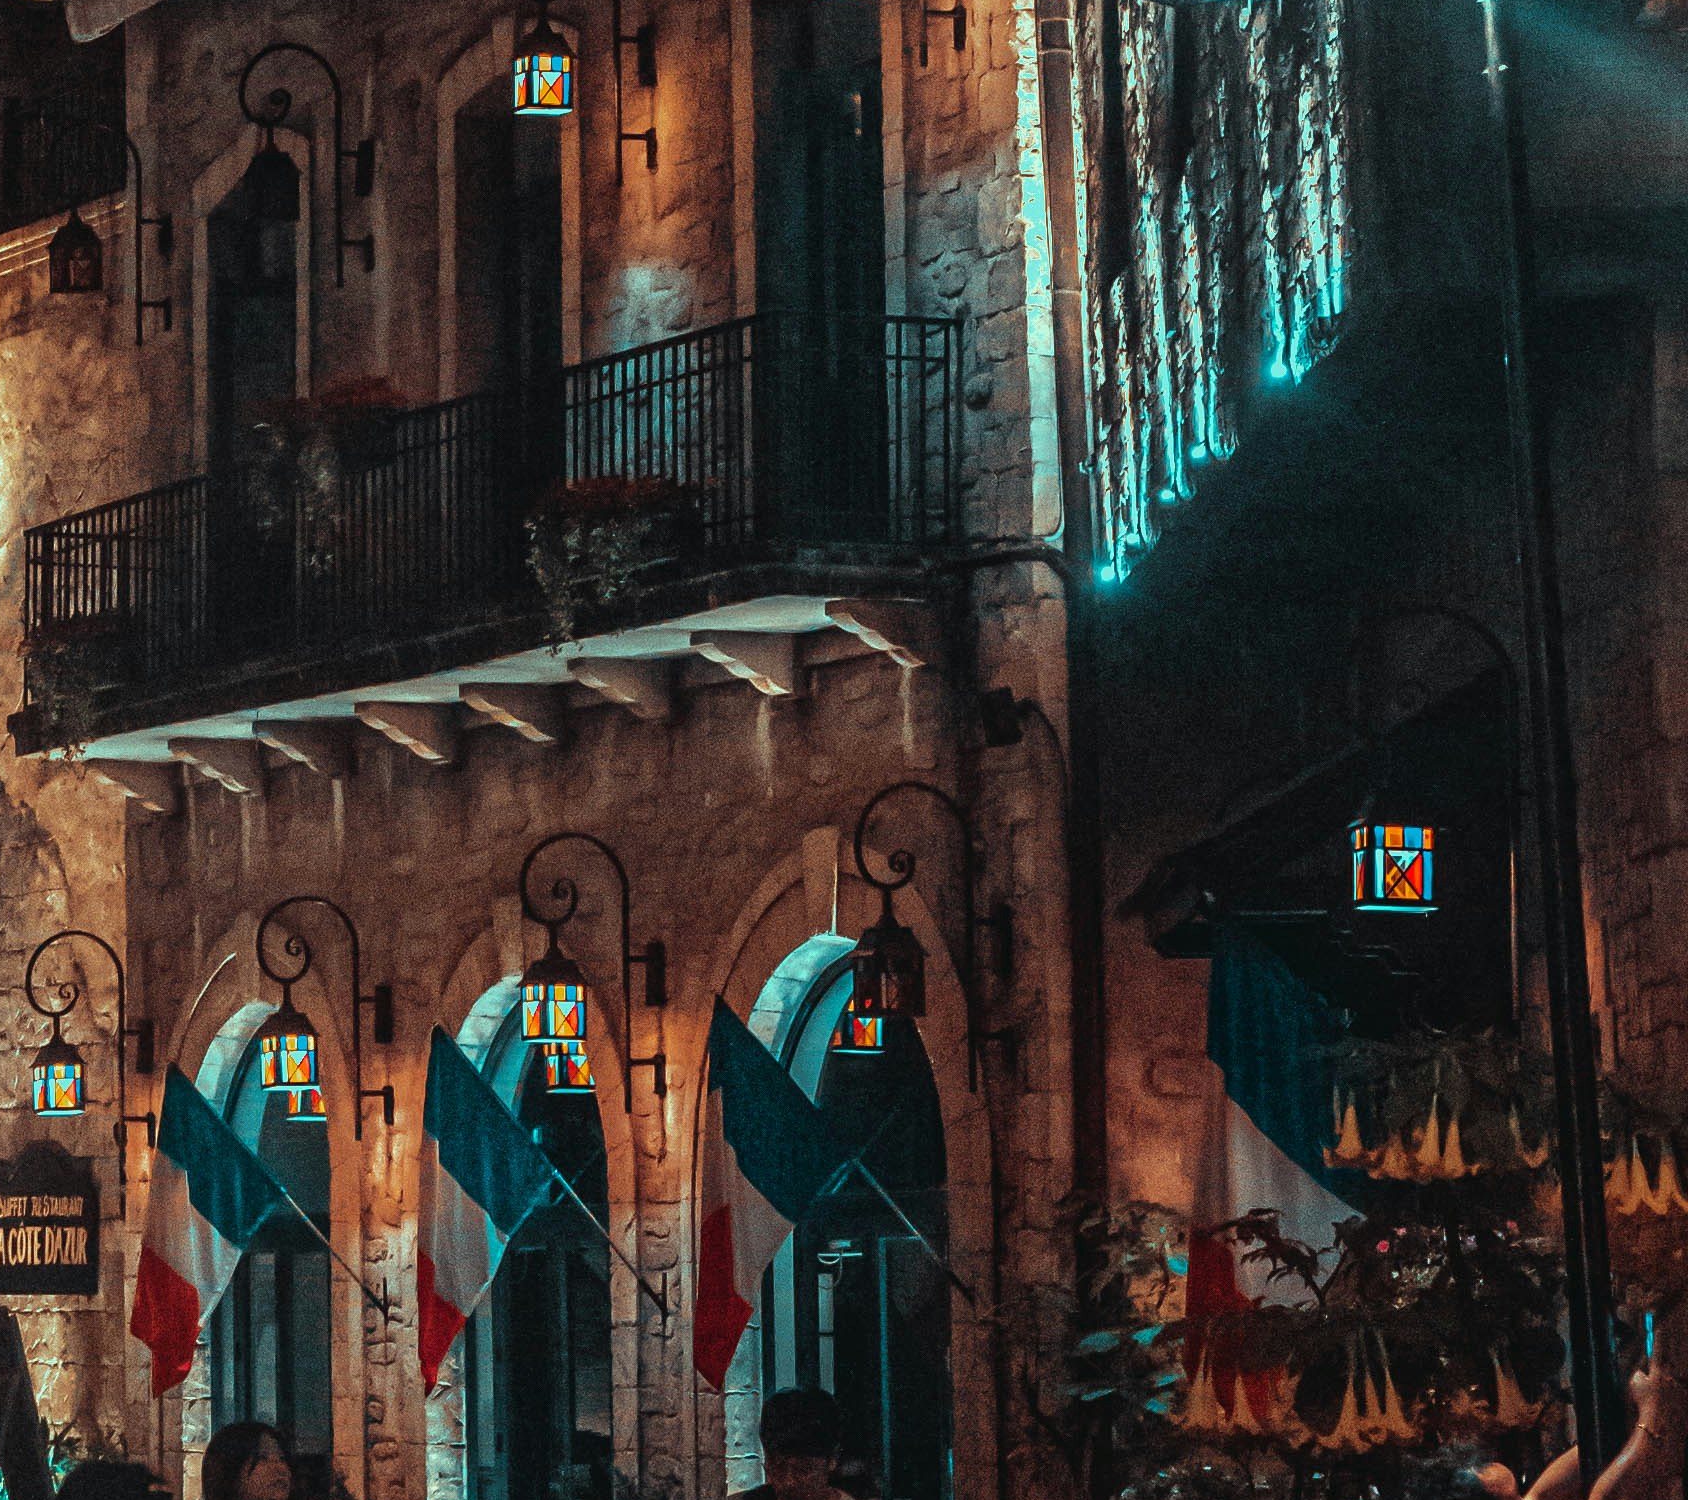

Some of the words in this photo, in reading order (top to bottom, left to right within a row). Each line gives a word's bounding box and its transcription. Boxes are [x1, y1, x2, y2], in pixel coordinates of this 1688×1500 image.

[31, 1195, 84, 1217] RESTAURANT
[8, 1221, 42, 1266] CÔTE
[44, 1223, 88, 1265] D'AZUR
